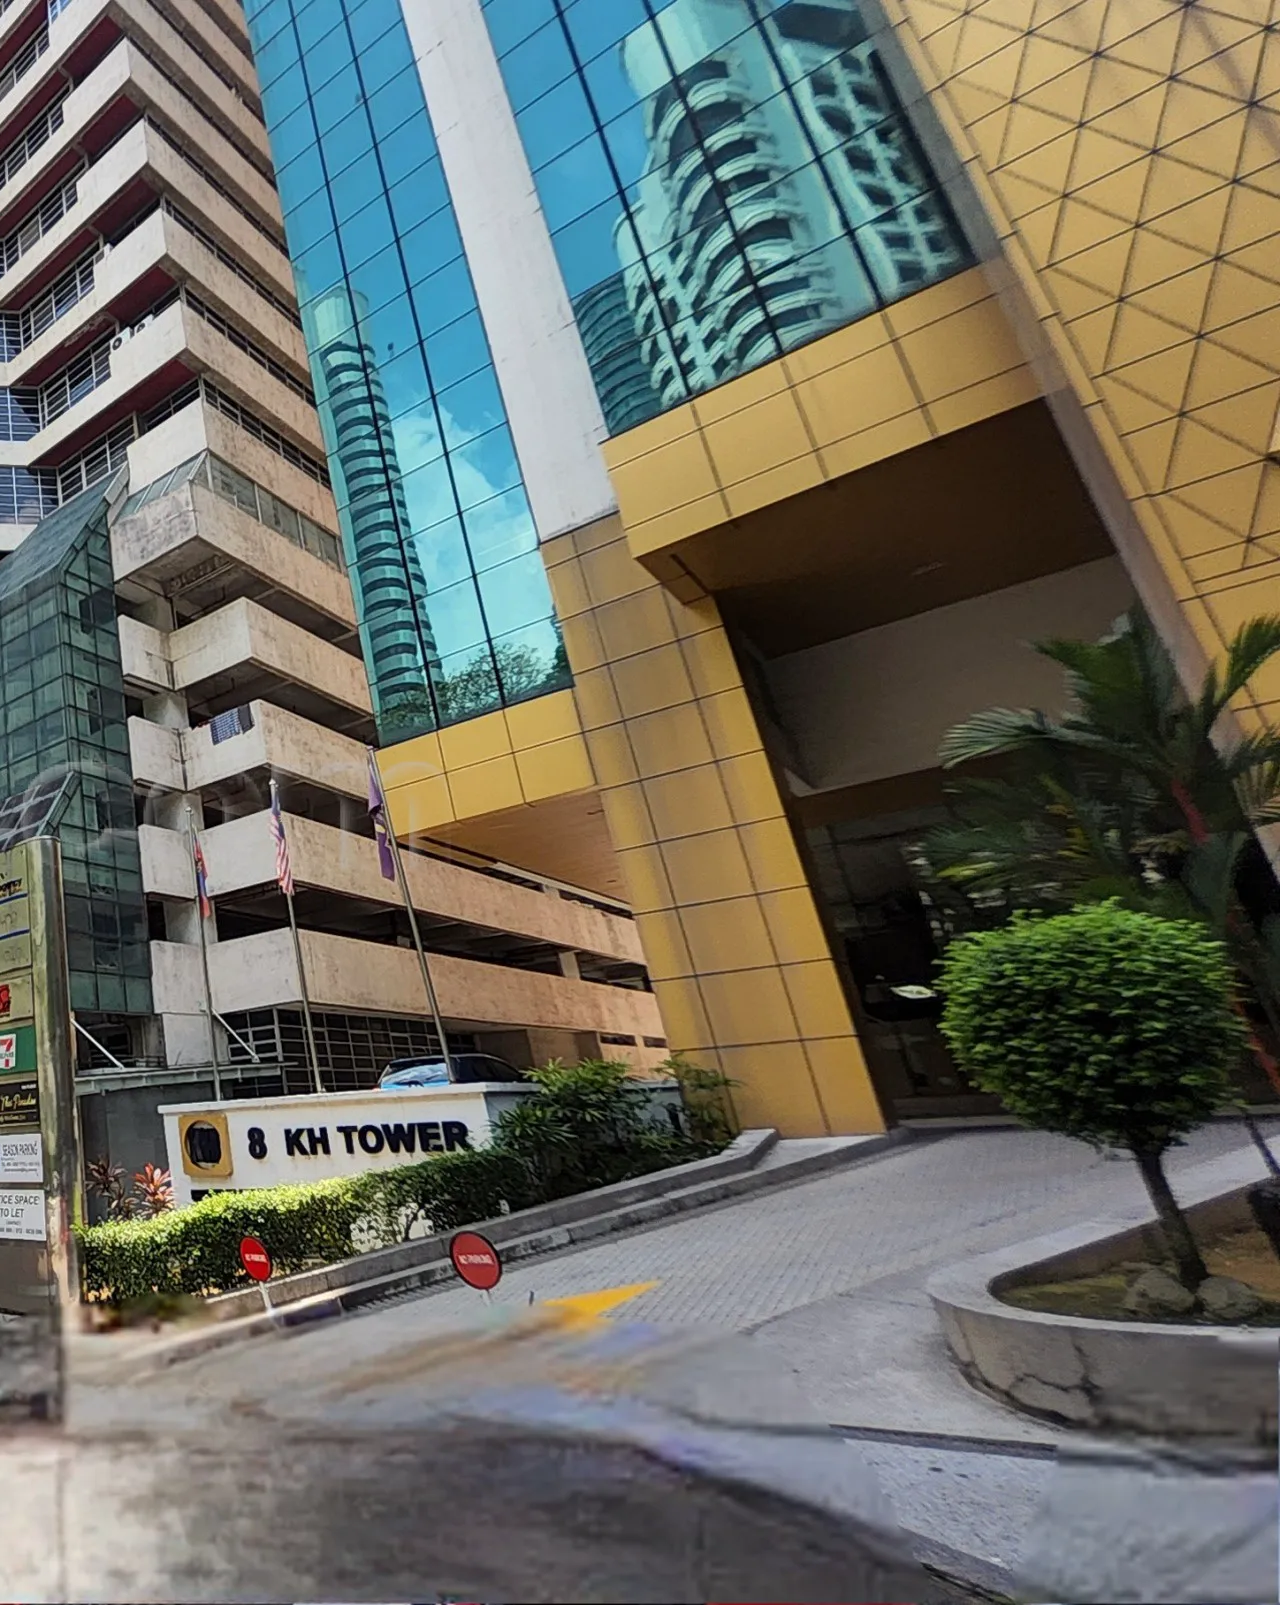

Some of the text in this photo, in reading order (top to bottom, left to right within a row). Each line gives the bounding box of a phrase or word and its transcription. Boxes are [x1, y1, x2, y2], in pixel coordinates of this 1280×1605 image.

[247, 1126, 268, 1160] 8
[284, 1127, 332, 1157] KH
[336, 1121, 474, 1155] TOWER
[14, 1195, 40, 1205] SPACE
[0, 1207, 24, 1218] TO LET
